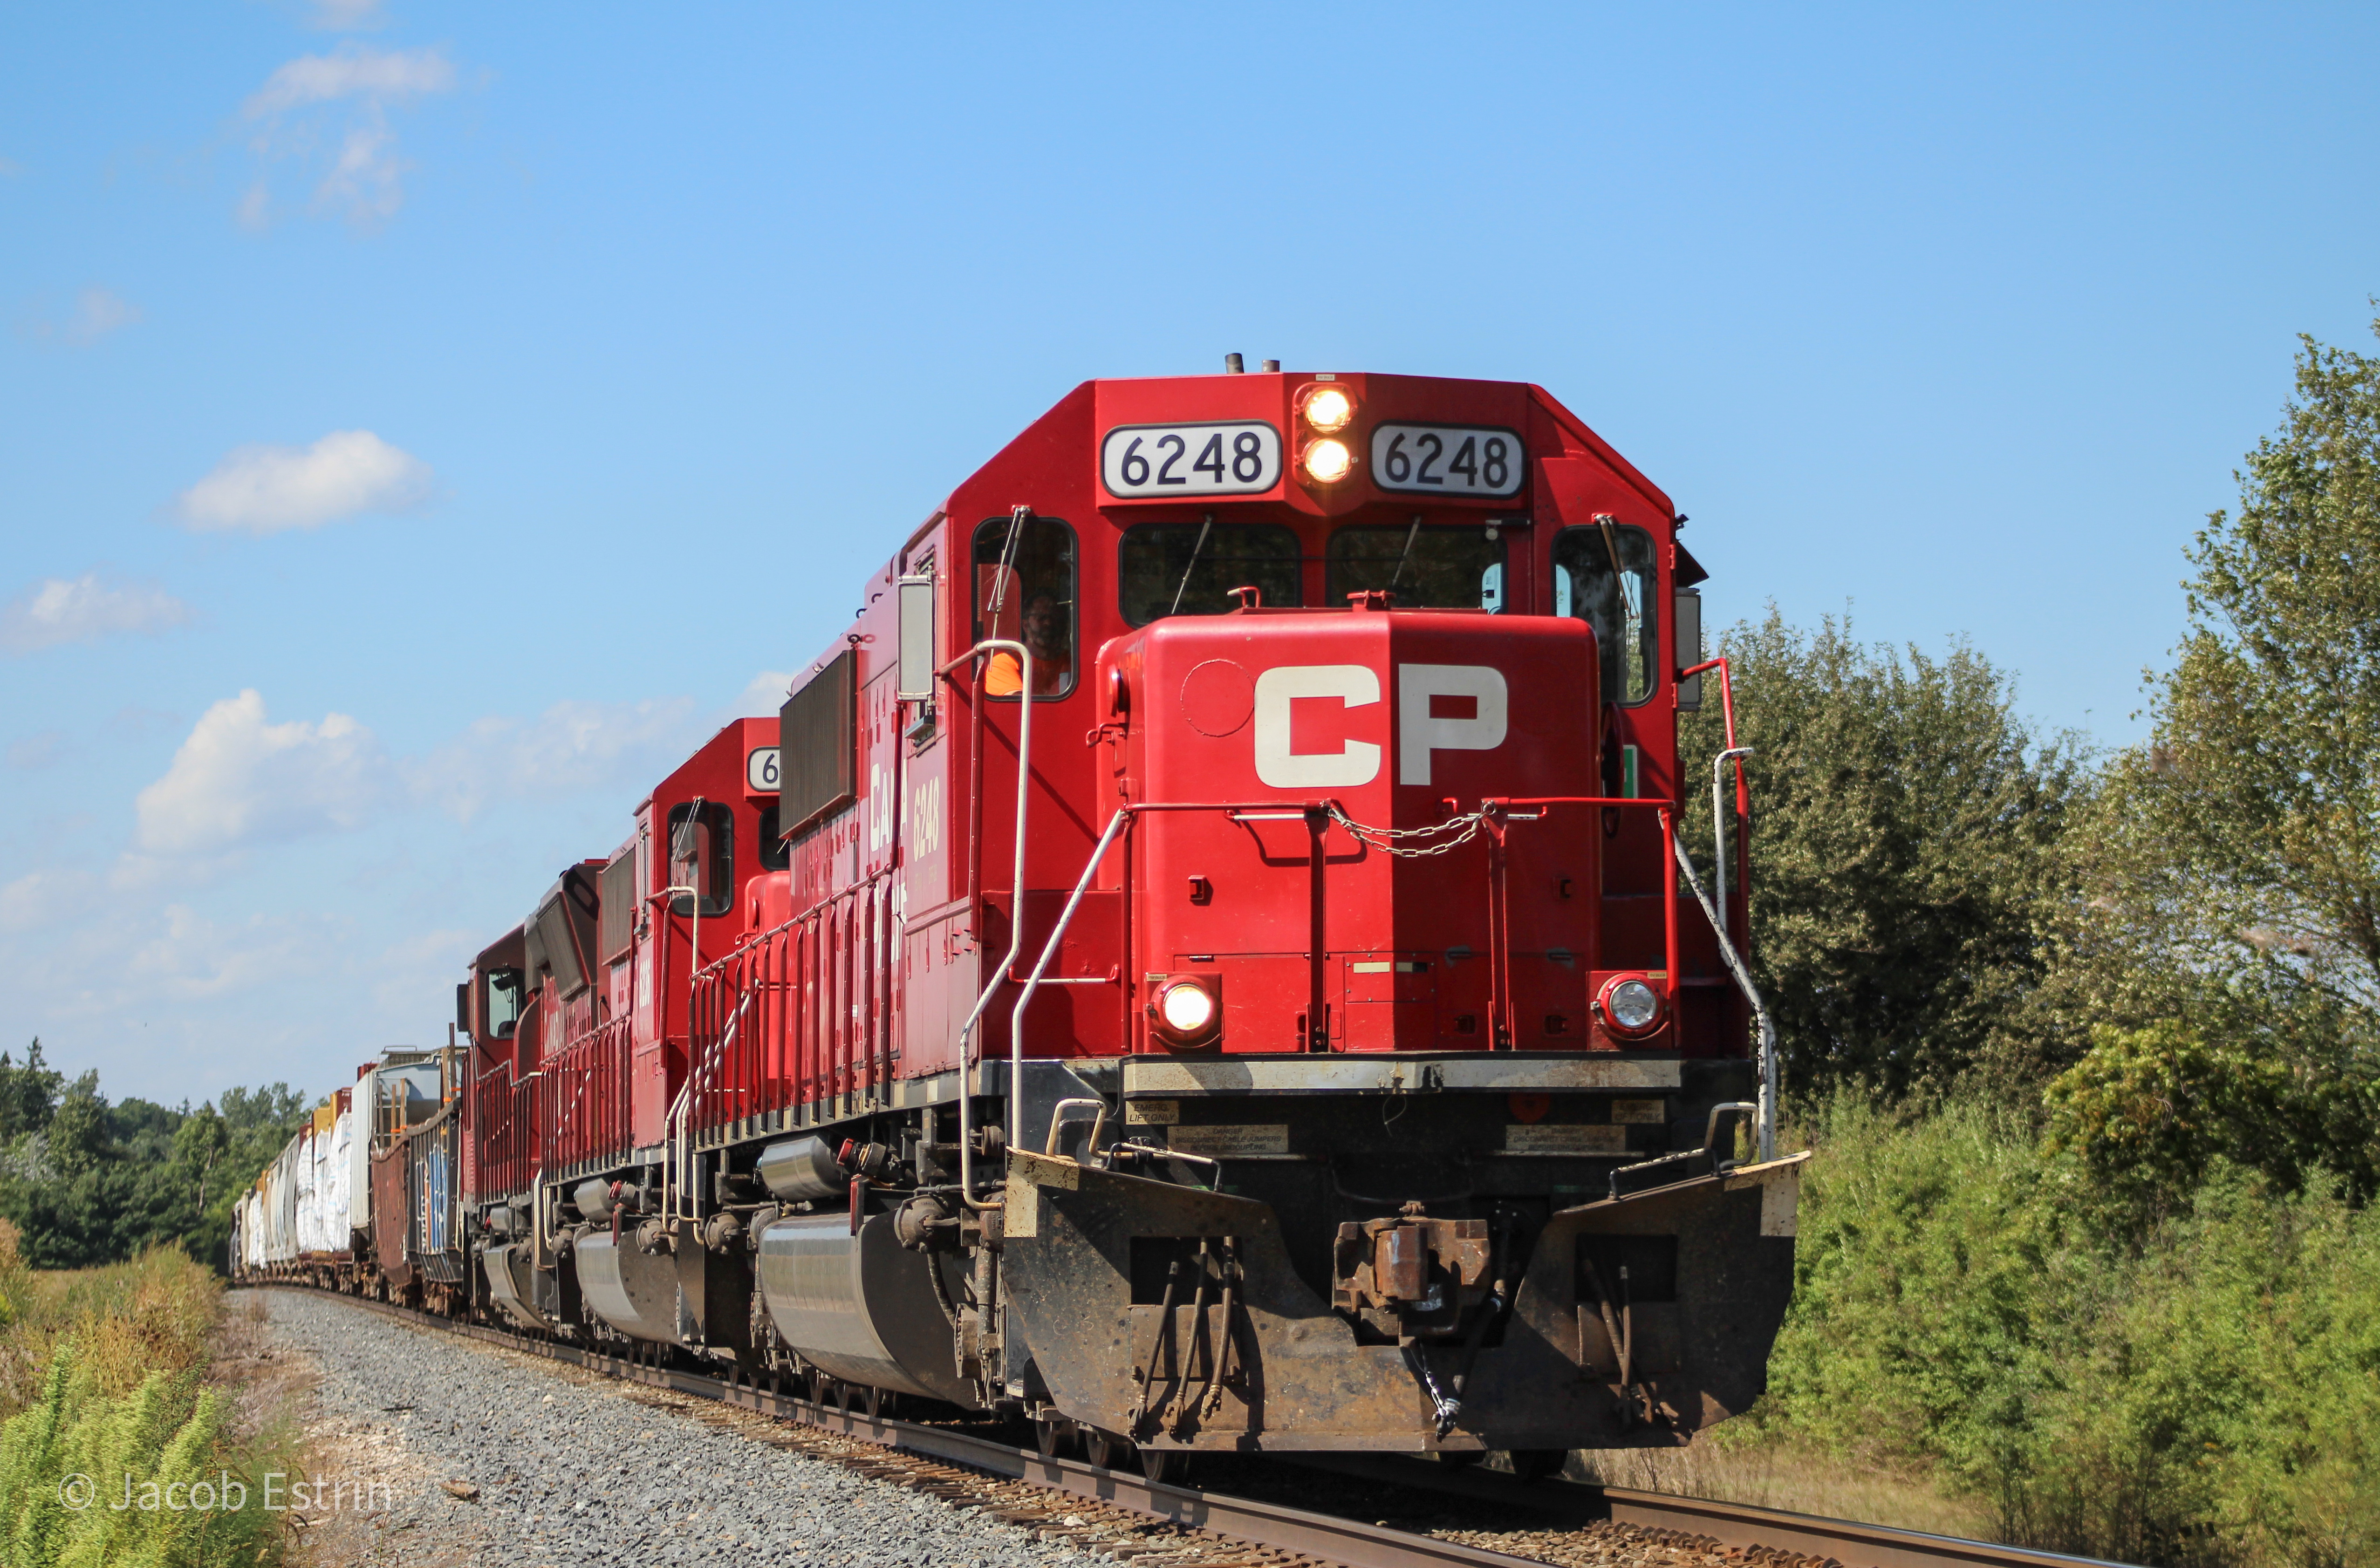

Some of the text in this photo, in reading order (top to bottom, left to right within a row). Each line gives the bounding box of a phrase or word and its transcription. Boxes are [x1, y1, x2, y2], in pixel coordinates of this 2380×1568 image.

[1121, 432, 1262, 486] 6248
[1385, 433, 1508, 489] 6248
[1254, 664, 1508, 788] CP
[914, 776, 939, 862] 6248
